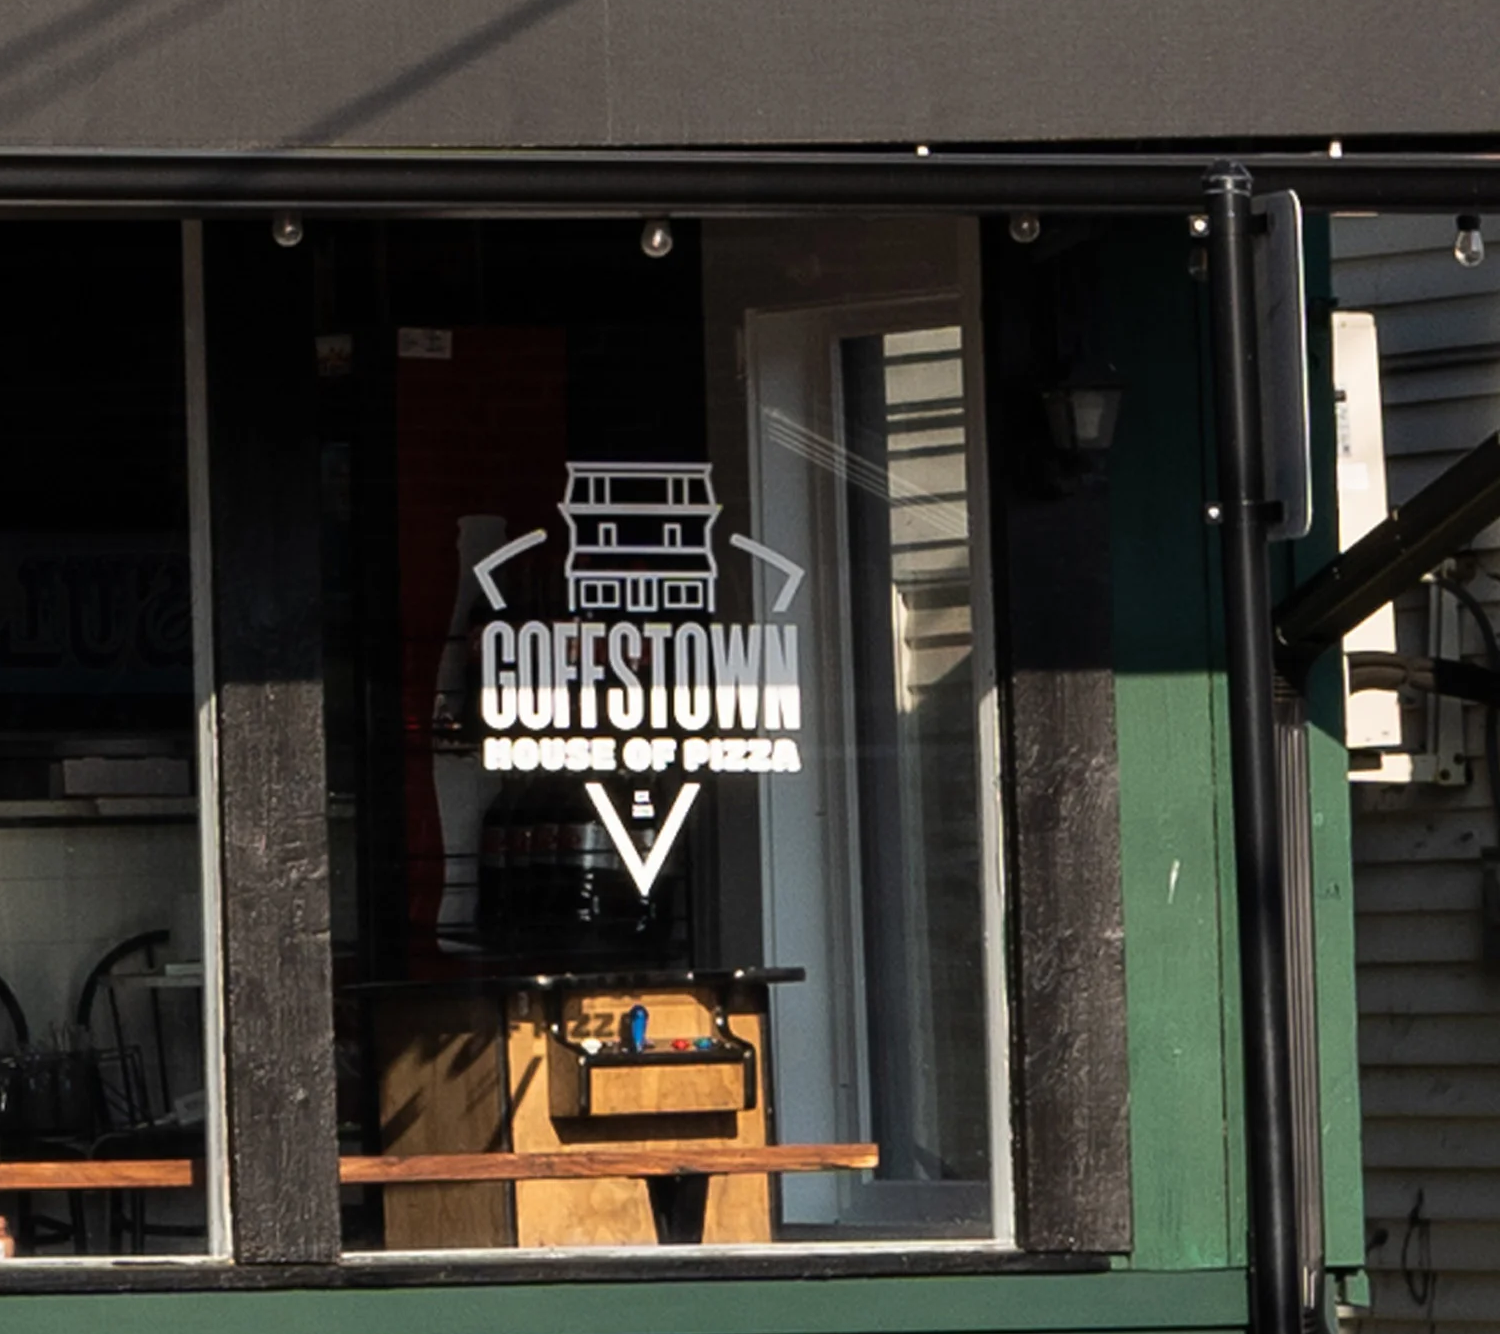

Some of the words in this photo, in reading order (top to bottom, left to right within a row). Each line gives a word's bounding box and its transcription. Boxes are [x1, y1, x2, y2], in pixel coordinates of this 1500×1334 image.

[480, 620, 802, 731] GOFFSTOWN
[482, 737, 617, 772] HOUSE
[622, 737, 678, 772] OF
[682, 737, 802, 773] PIZZA
